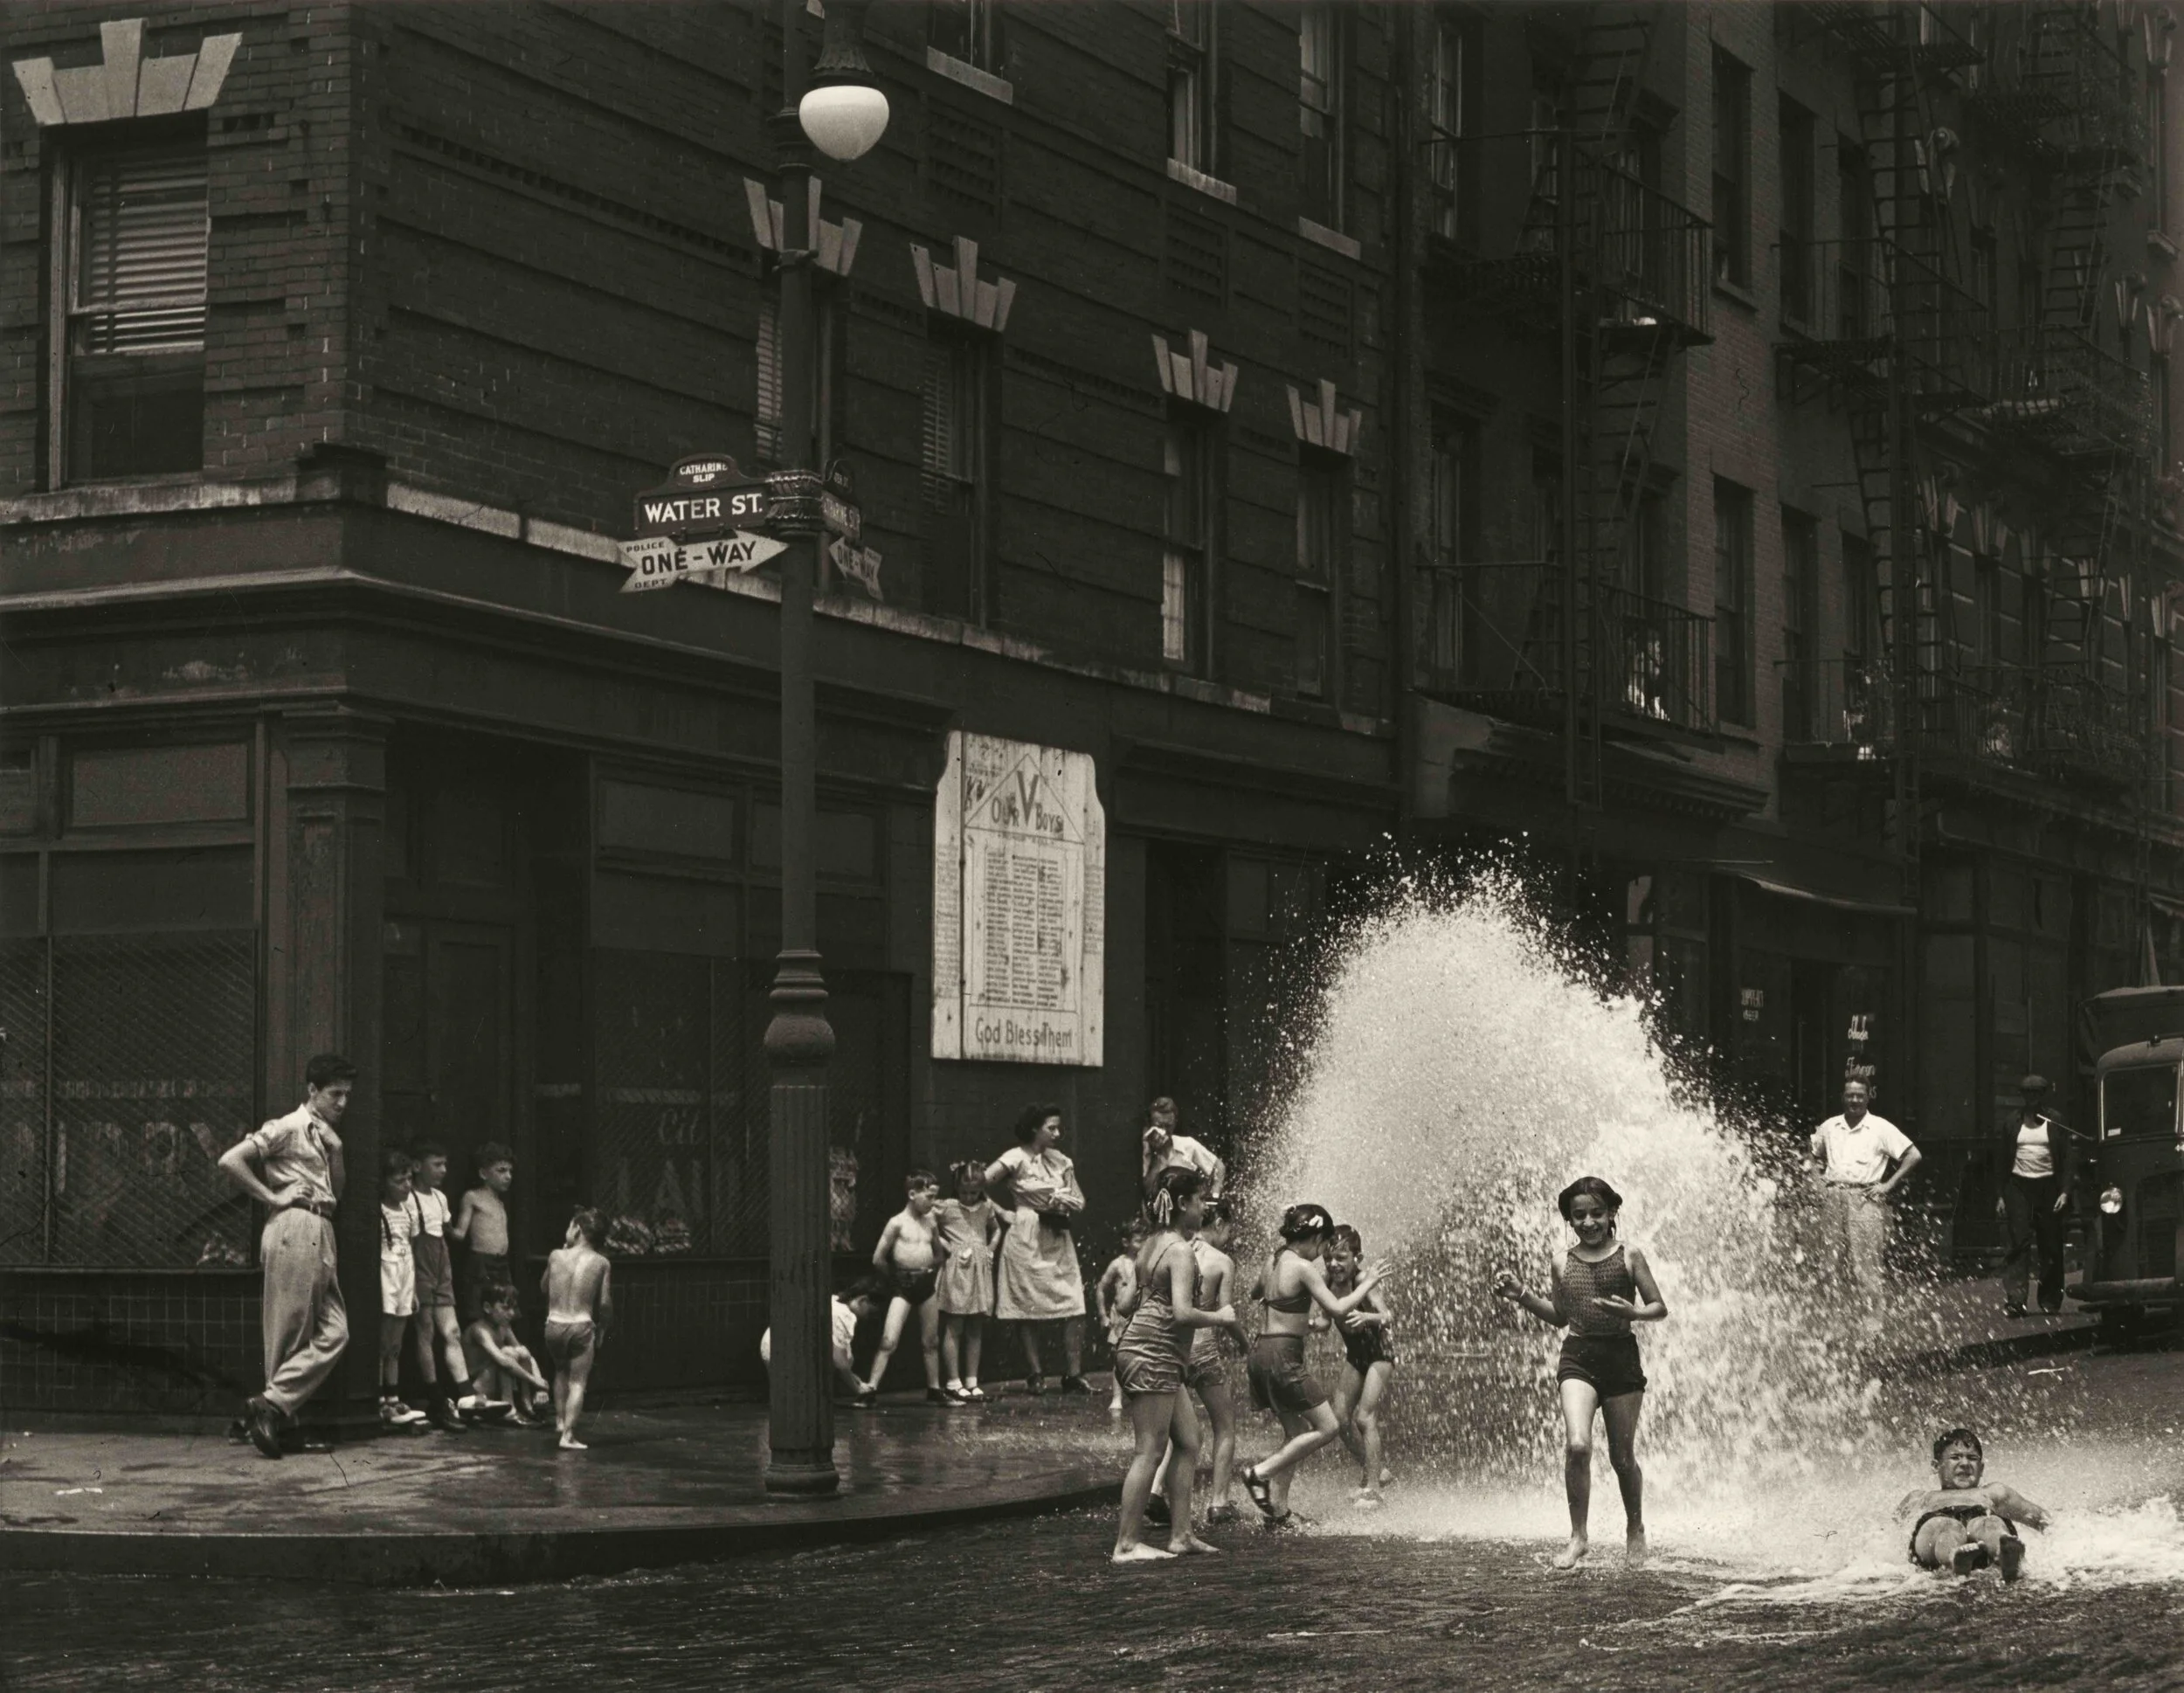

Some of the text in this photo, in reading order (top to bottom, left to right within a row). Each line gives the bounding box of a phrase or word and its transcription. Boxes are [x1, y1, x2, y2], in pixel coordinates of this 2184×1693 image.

[680, 462, 729, 475] CATHARINE
[693, 473, 715, 483] SLIP
[644, 493, 763, 523] WATER ST.
[626, 542, 664, 552] POLICE
[1017, 770, 1039, 826] V
[976, 1017, 1001, 1045] God
[1006, 1019, 1040, 1046] Bless
